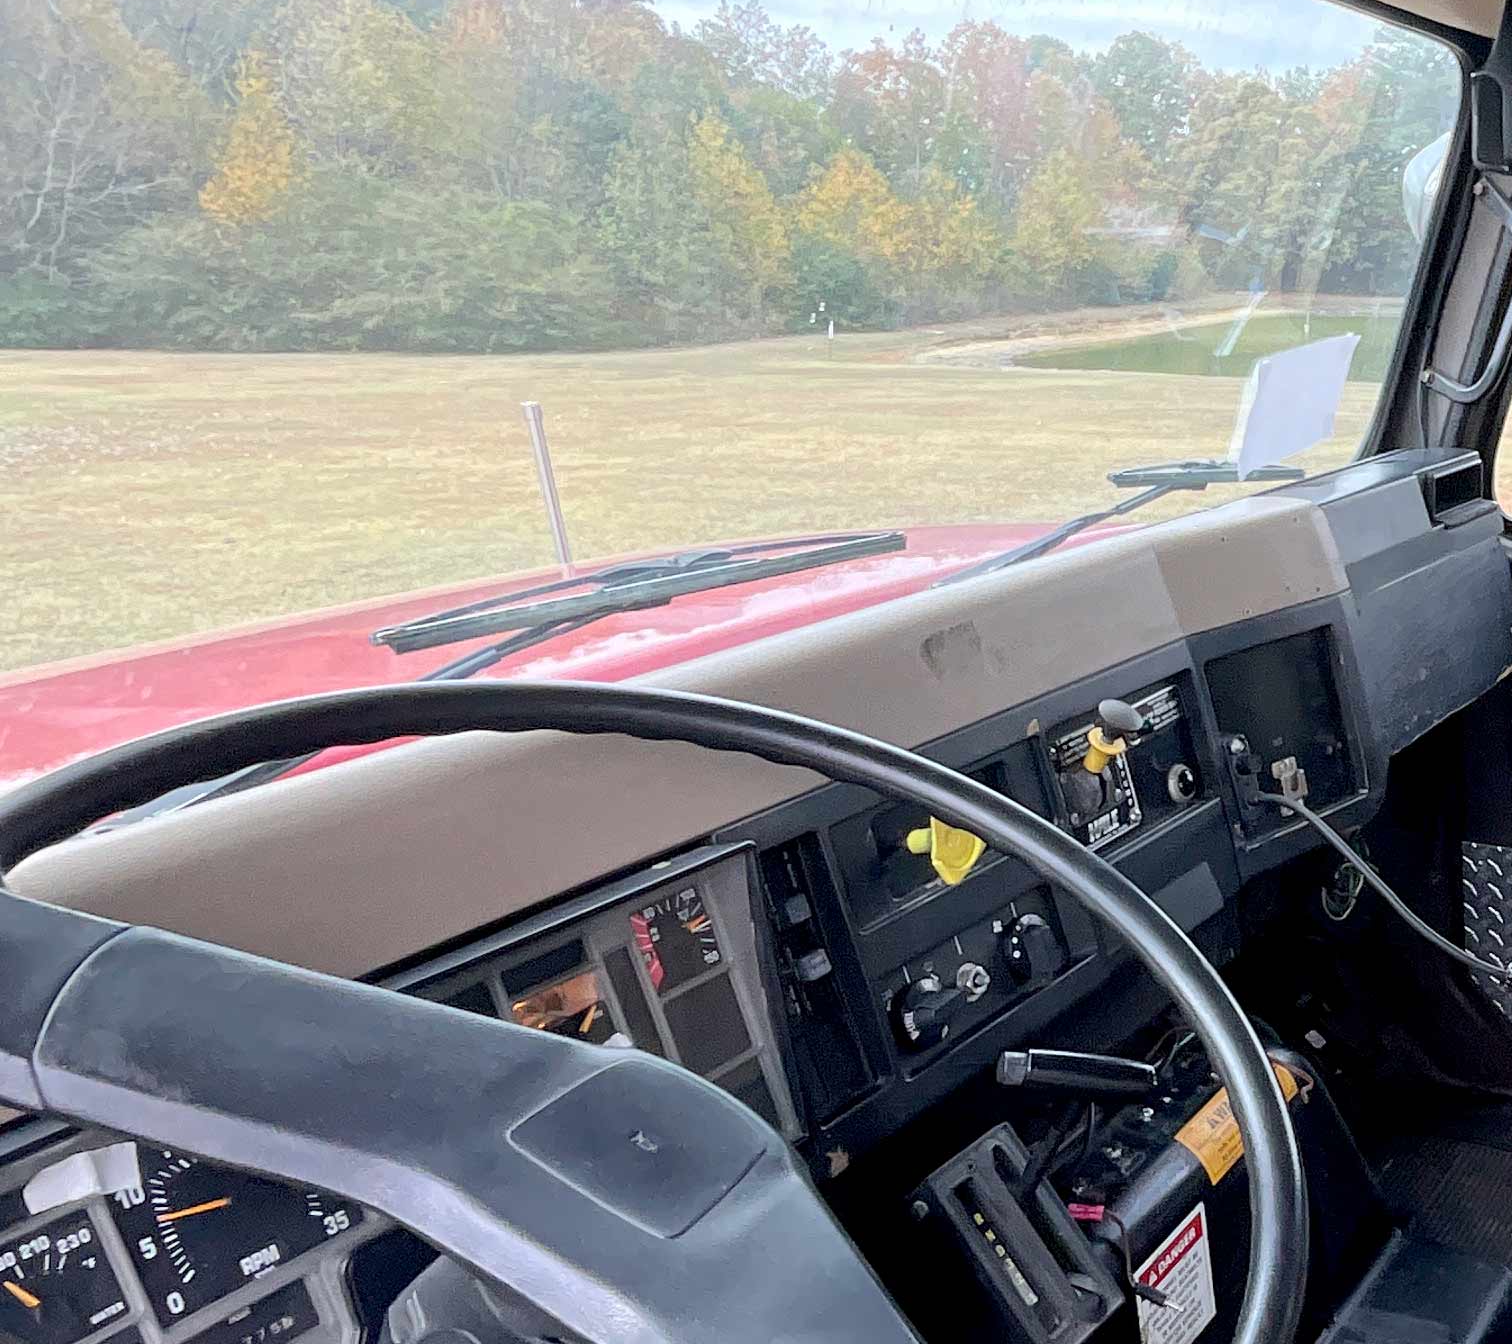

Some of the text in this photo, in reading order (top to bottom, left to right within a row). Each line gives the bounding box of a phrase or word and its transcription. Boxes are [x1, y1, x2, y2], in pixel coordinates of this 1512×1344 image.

[114, 1186, 146, 1210] 10
[323, 1210, 350, 1236] 35
[137, 1235, 158, 1260] 5
[238, 1243, 281, 1277] RPM
[1157, 1226, 1197, 1275] DANGER
[165, 1291, 186, 1315] 0
